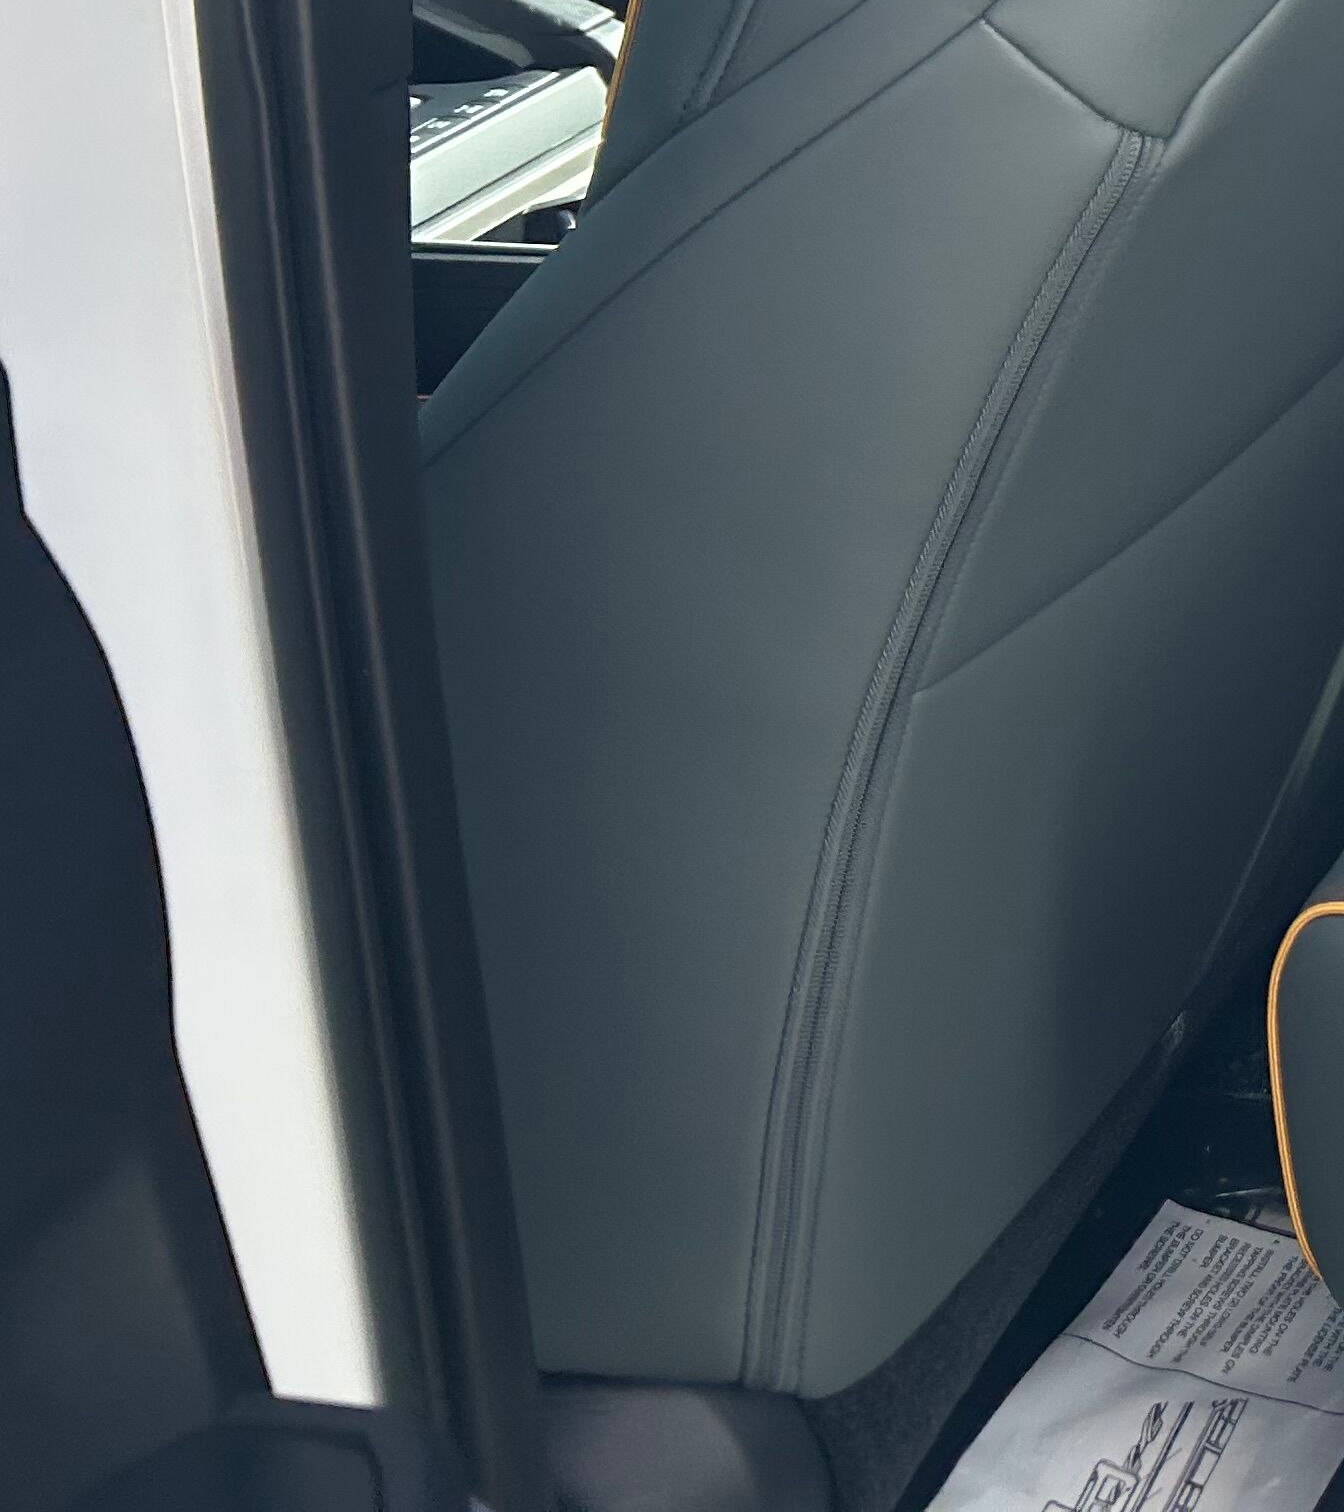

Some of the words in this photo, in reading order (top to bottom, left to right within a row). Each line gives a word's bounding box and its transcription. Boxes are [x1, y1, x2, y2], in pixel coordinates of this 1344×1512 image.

[1281, 1253, 1299, 1272] THE
[1198, 1279, 1223, 1308] HOLES
[1211, 1276, 1240, 1312] SCREWS
[1235, 1277, 1254, 1299] TWO
[1176, 1320, 1194, 1340] THE
[1261, 1337, 1279, 1357] THE
[1310, 1348, 1329, 1370] THE
[1322, 1353, 1340, 1373] THE
